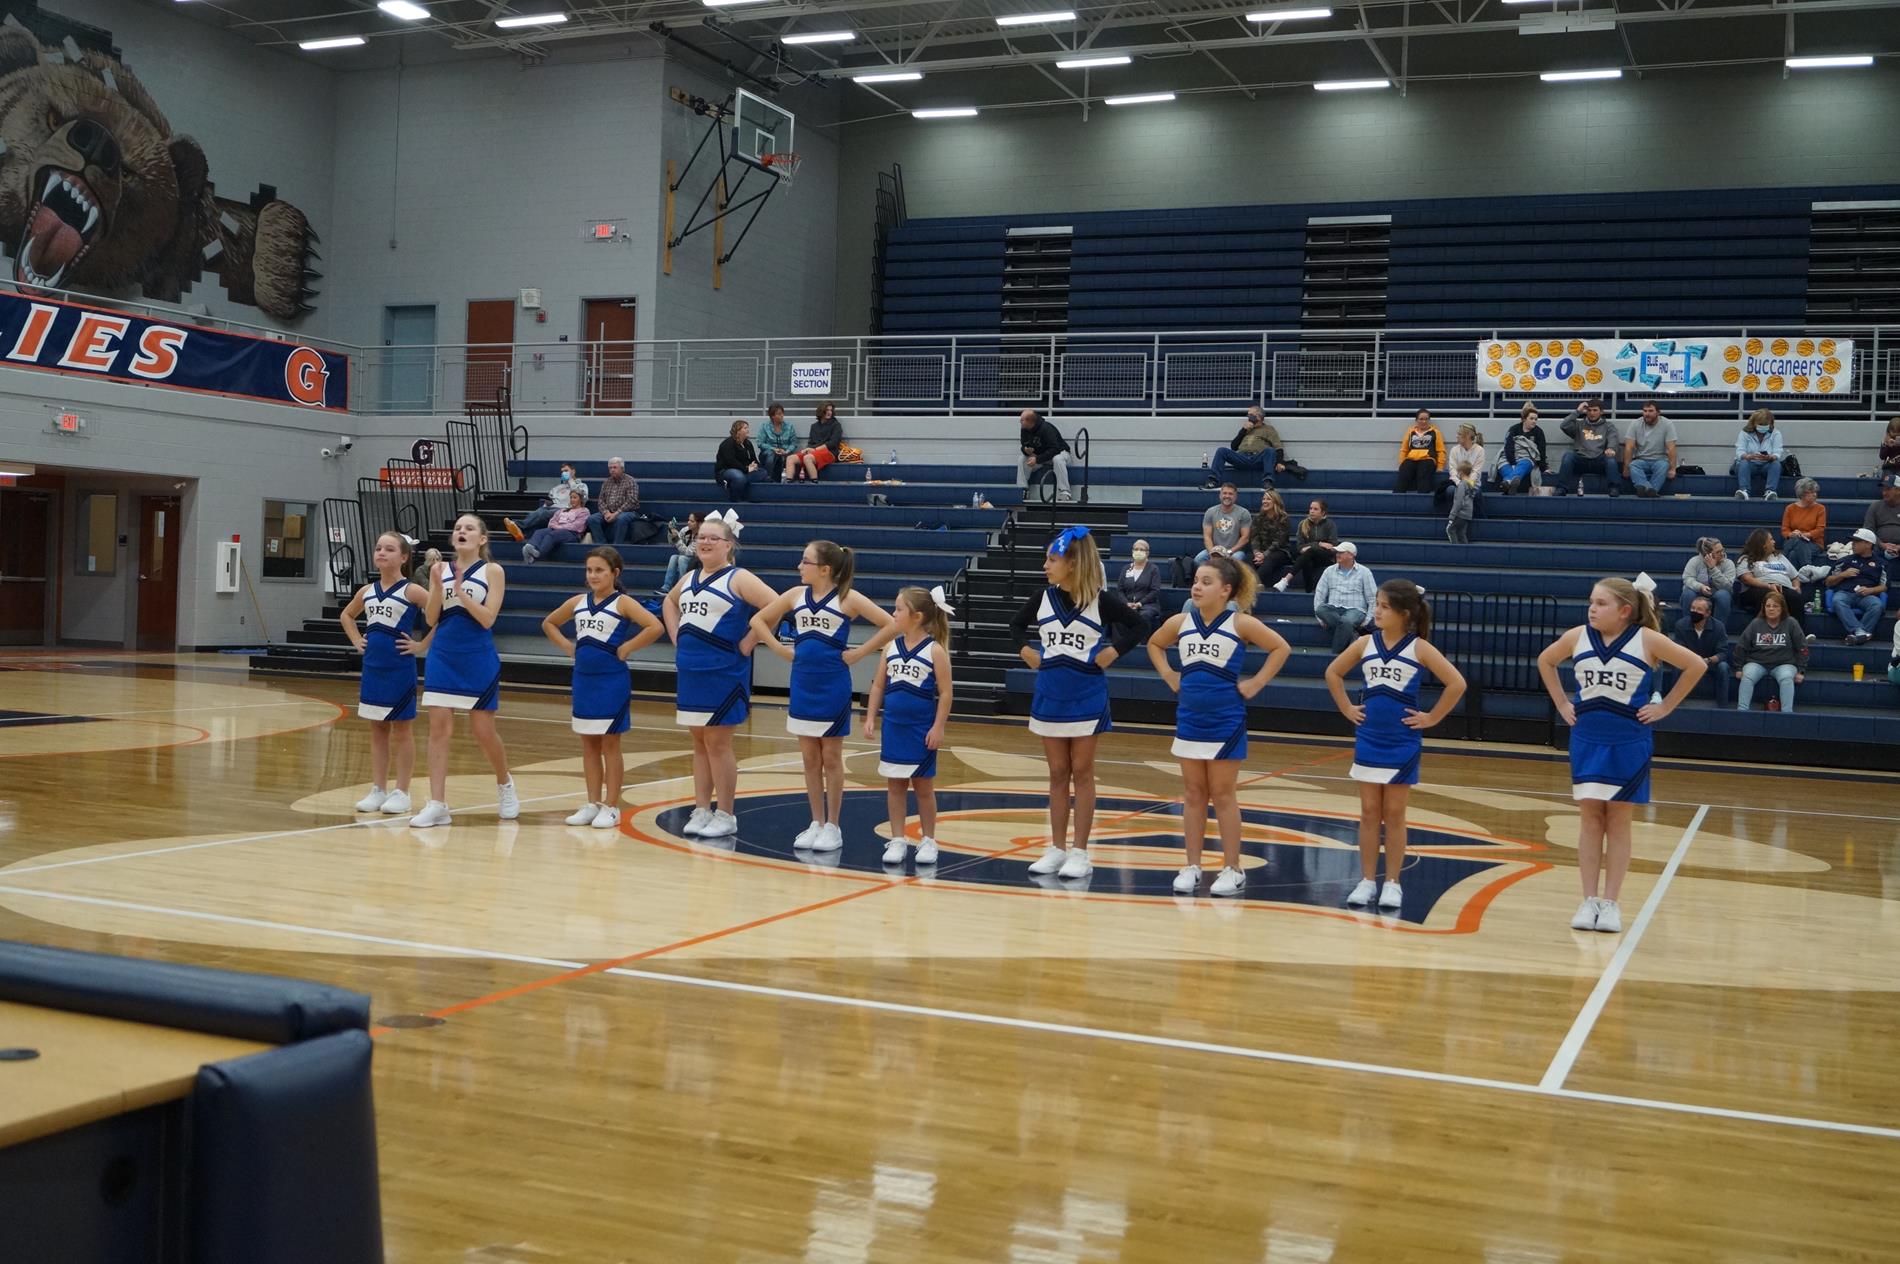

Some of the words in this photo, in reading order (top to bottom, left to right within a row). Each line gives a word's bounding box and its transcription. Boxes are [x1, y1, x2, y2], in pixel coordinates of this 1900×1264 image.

[0, 303, 188, 379] IES
[1533, 357, 1574, 380] GO
[1646, 355, 1659, 367] BLUE
[1659, 362, 1669, 374] AND
[1746, 356, 1823, 377] Buccaneers
[284, 346, 330, 408] G
[792, 368, 831, 377] STUDENT
[793, 379, 829, 388] SECTION
[63, 414, 78, 430] EXIT
[445, 588, 473, 600] RS
[368, 605, 393, 619] RES
[680, 601, 708, 617] RES
[579, 618, 604, 632] RES
[801, 616, 830, 630] RES
[1046, 631, 1086, 651] RES
[1187, 643, 1220, 658] RES
[892, 664, 920, 679] RES
[1369, 666, 1402, 682] RES
[1583, 670, 1627, 691] RES
